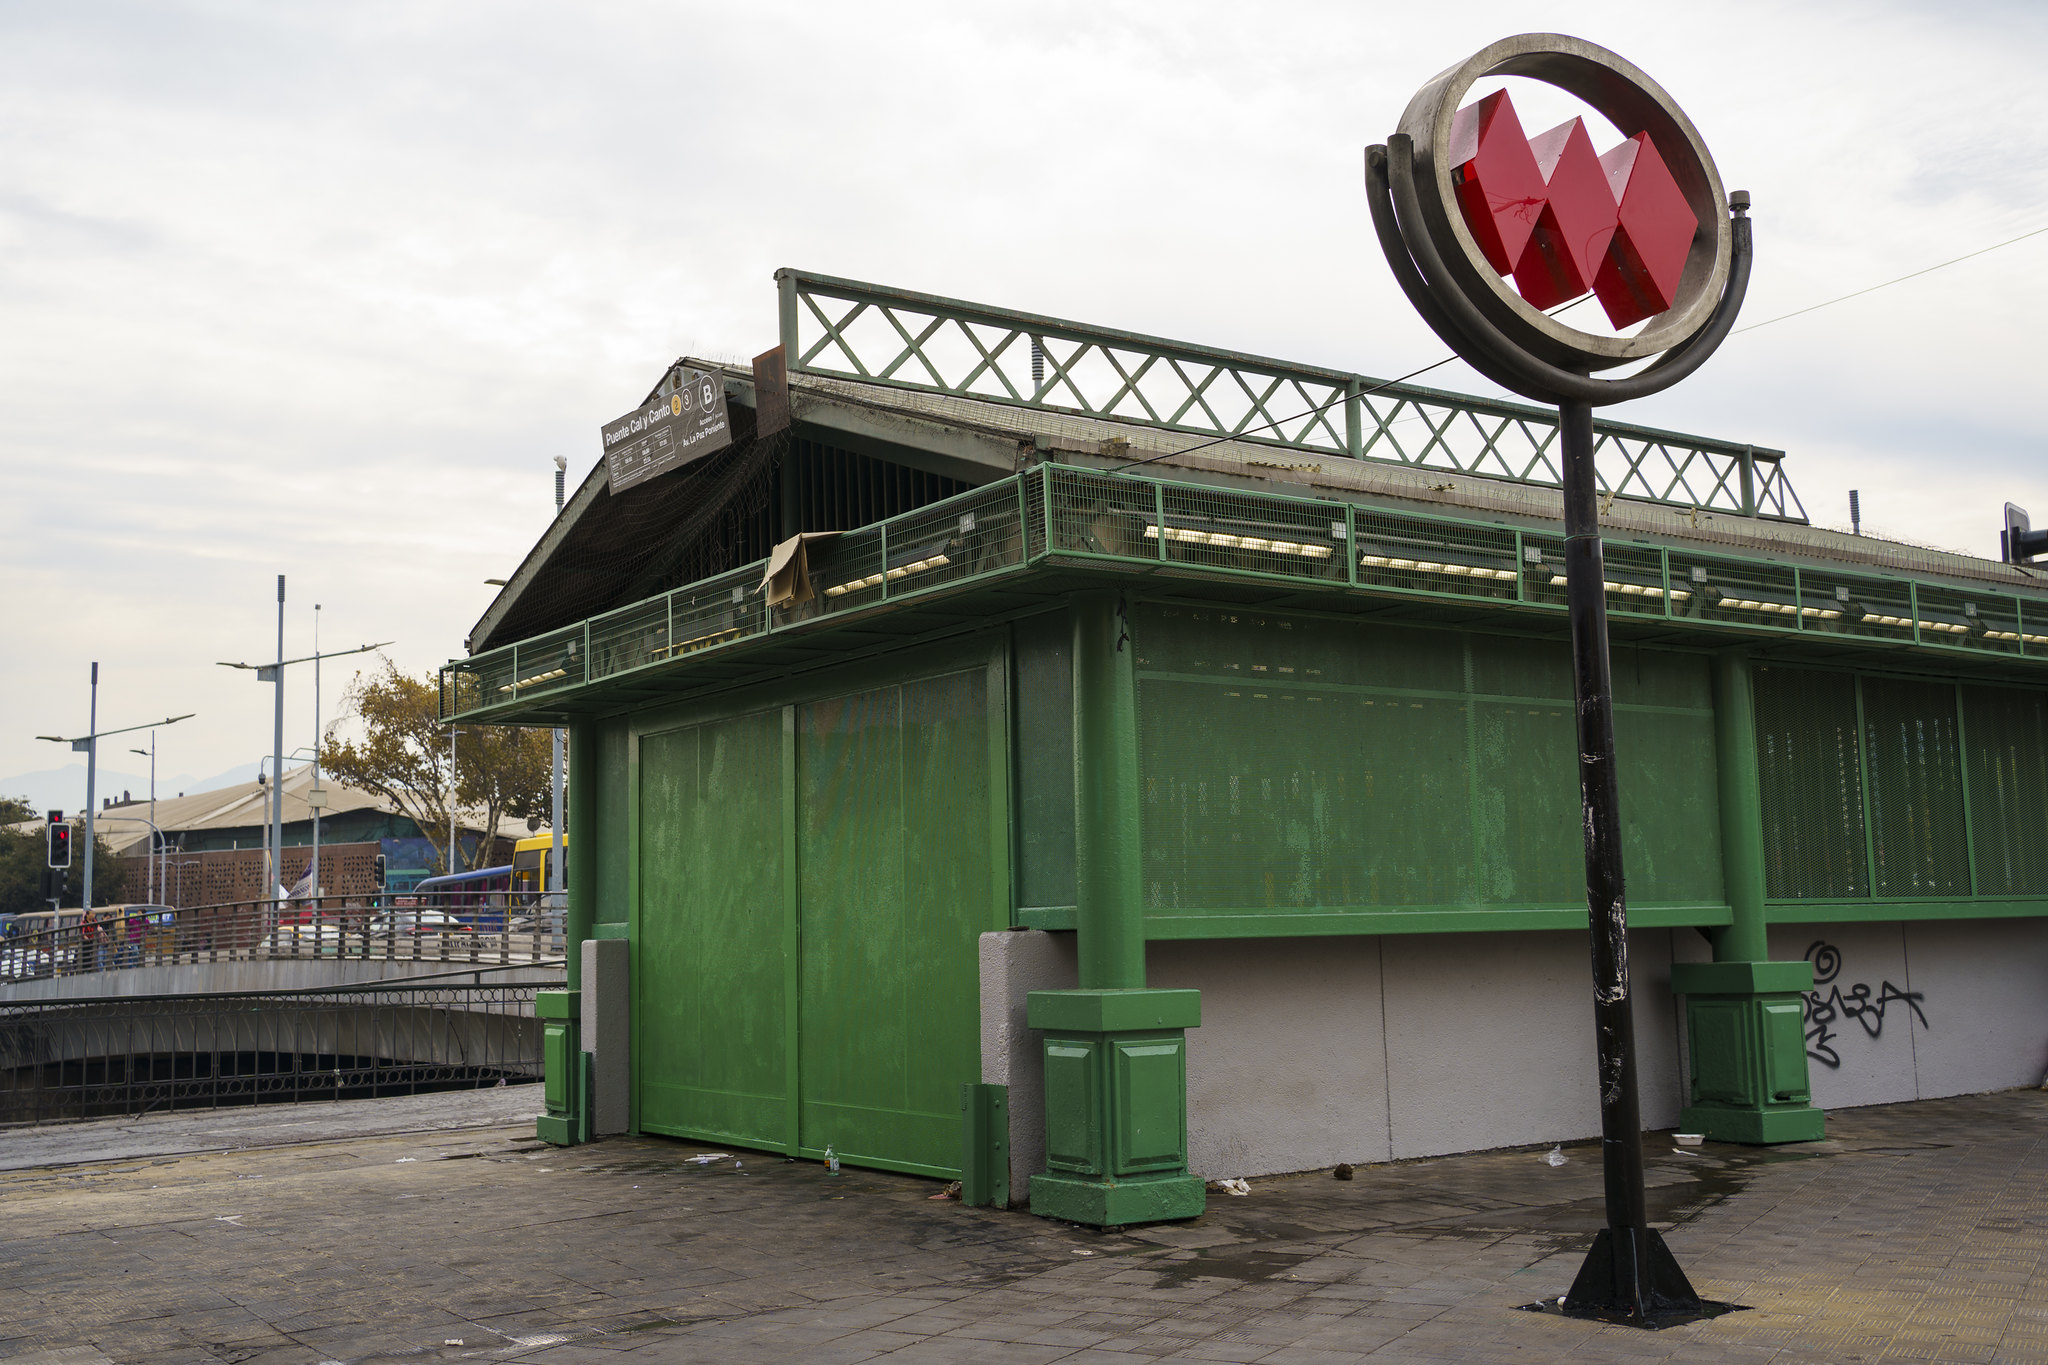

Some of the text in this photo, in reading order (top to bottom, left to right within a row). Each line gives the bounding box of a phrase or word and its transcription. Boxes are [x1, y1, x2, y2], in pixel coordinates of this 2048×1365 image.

[703, 384, 713, 405] B
[606, 427, 629, 446] Puente
[630, 419, 643, 434] Cal
[642, 415, 649, 430] y
[648, 404, 670, 423] Canto
[684, 394, 690, 405] 3
[689, 434, 697, 444] La
[696, 430, 705, 441] Paz
[704, 421, 726, 437] Poniente
